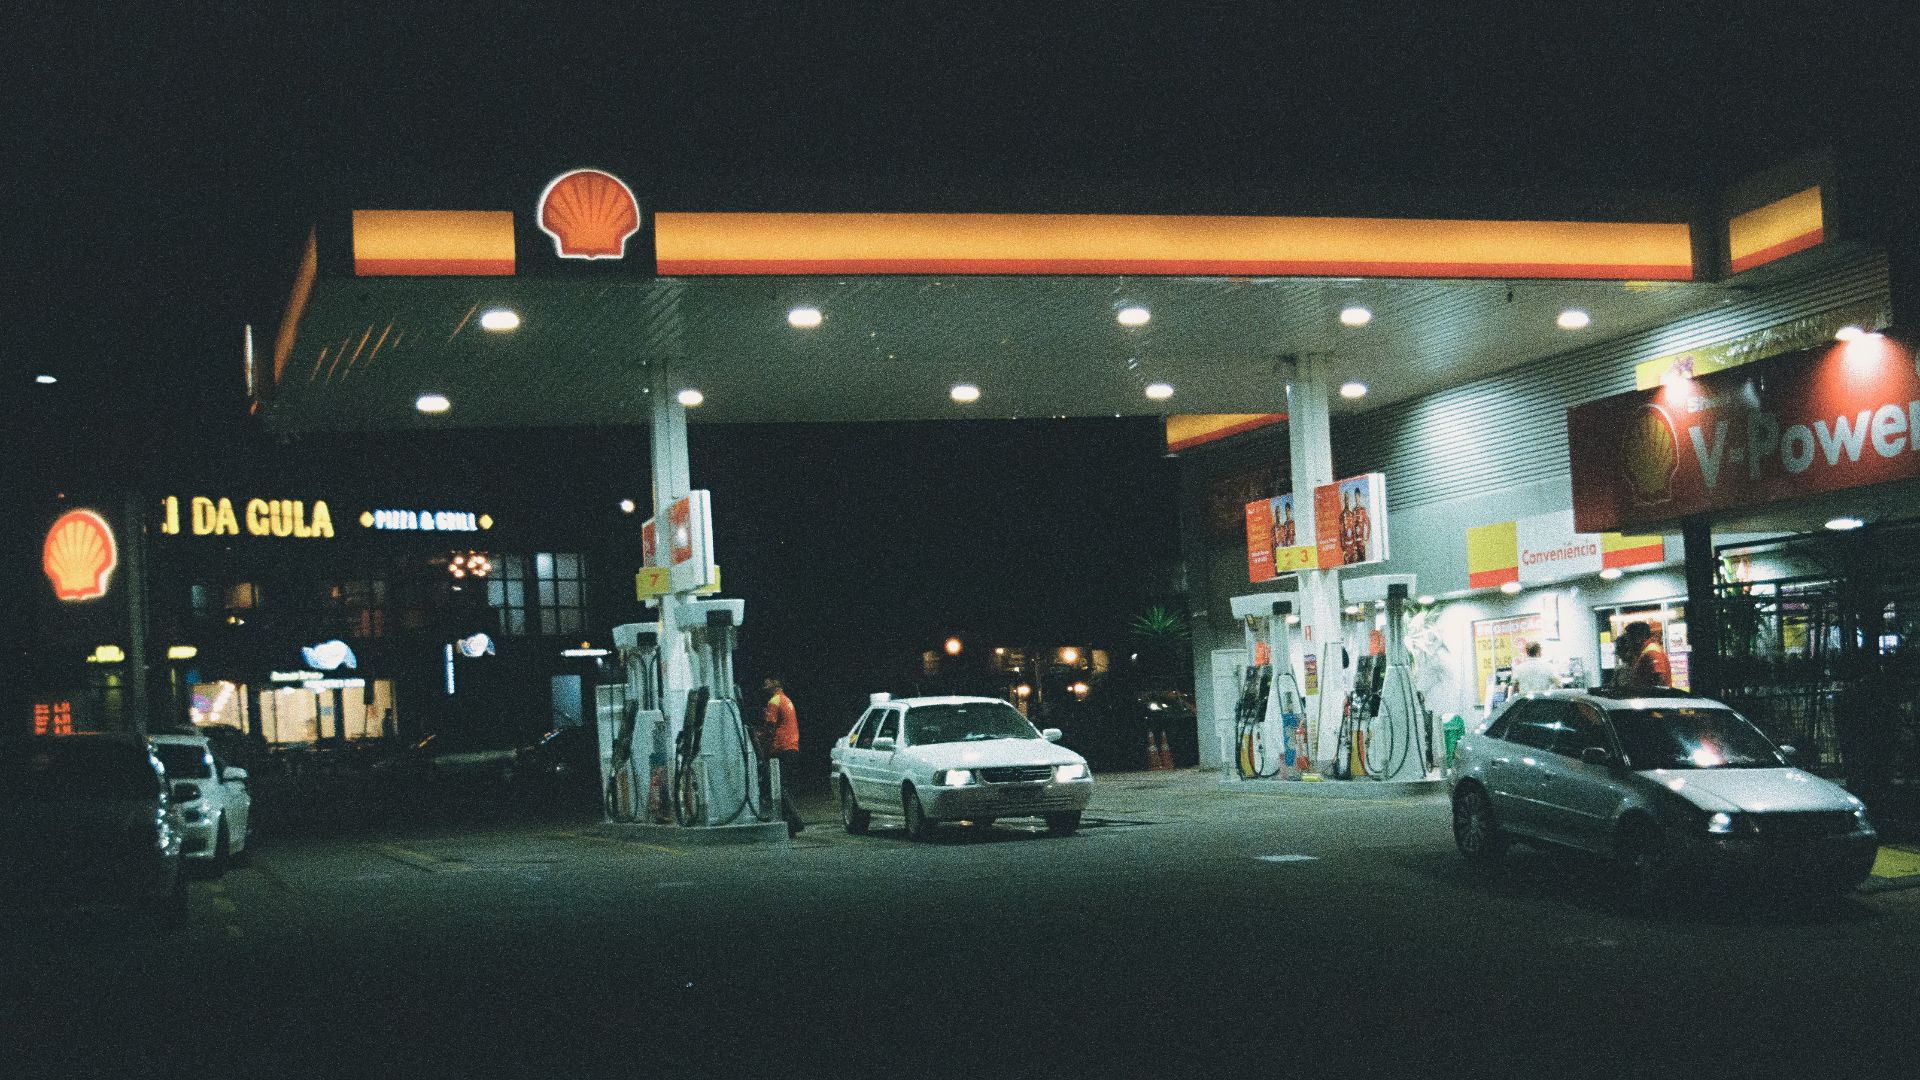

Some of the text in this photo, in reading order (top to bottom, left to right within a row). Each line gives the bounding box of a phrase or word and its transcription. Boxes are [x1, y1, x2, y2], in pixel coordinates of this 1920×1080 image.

[191, 496, 240, 536] DA
[245, 497, 335, 539] GULA
[1300, 550, 1309, 563] 3
[1522, 541, 1597, 567] Conveniência
[650, 573, 660, 587] 7
